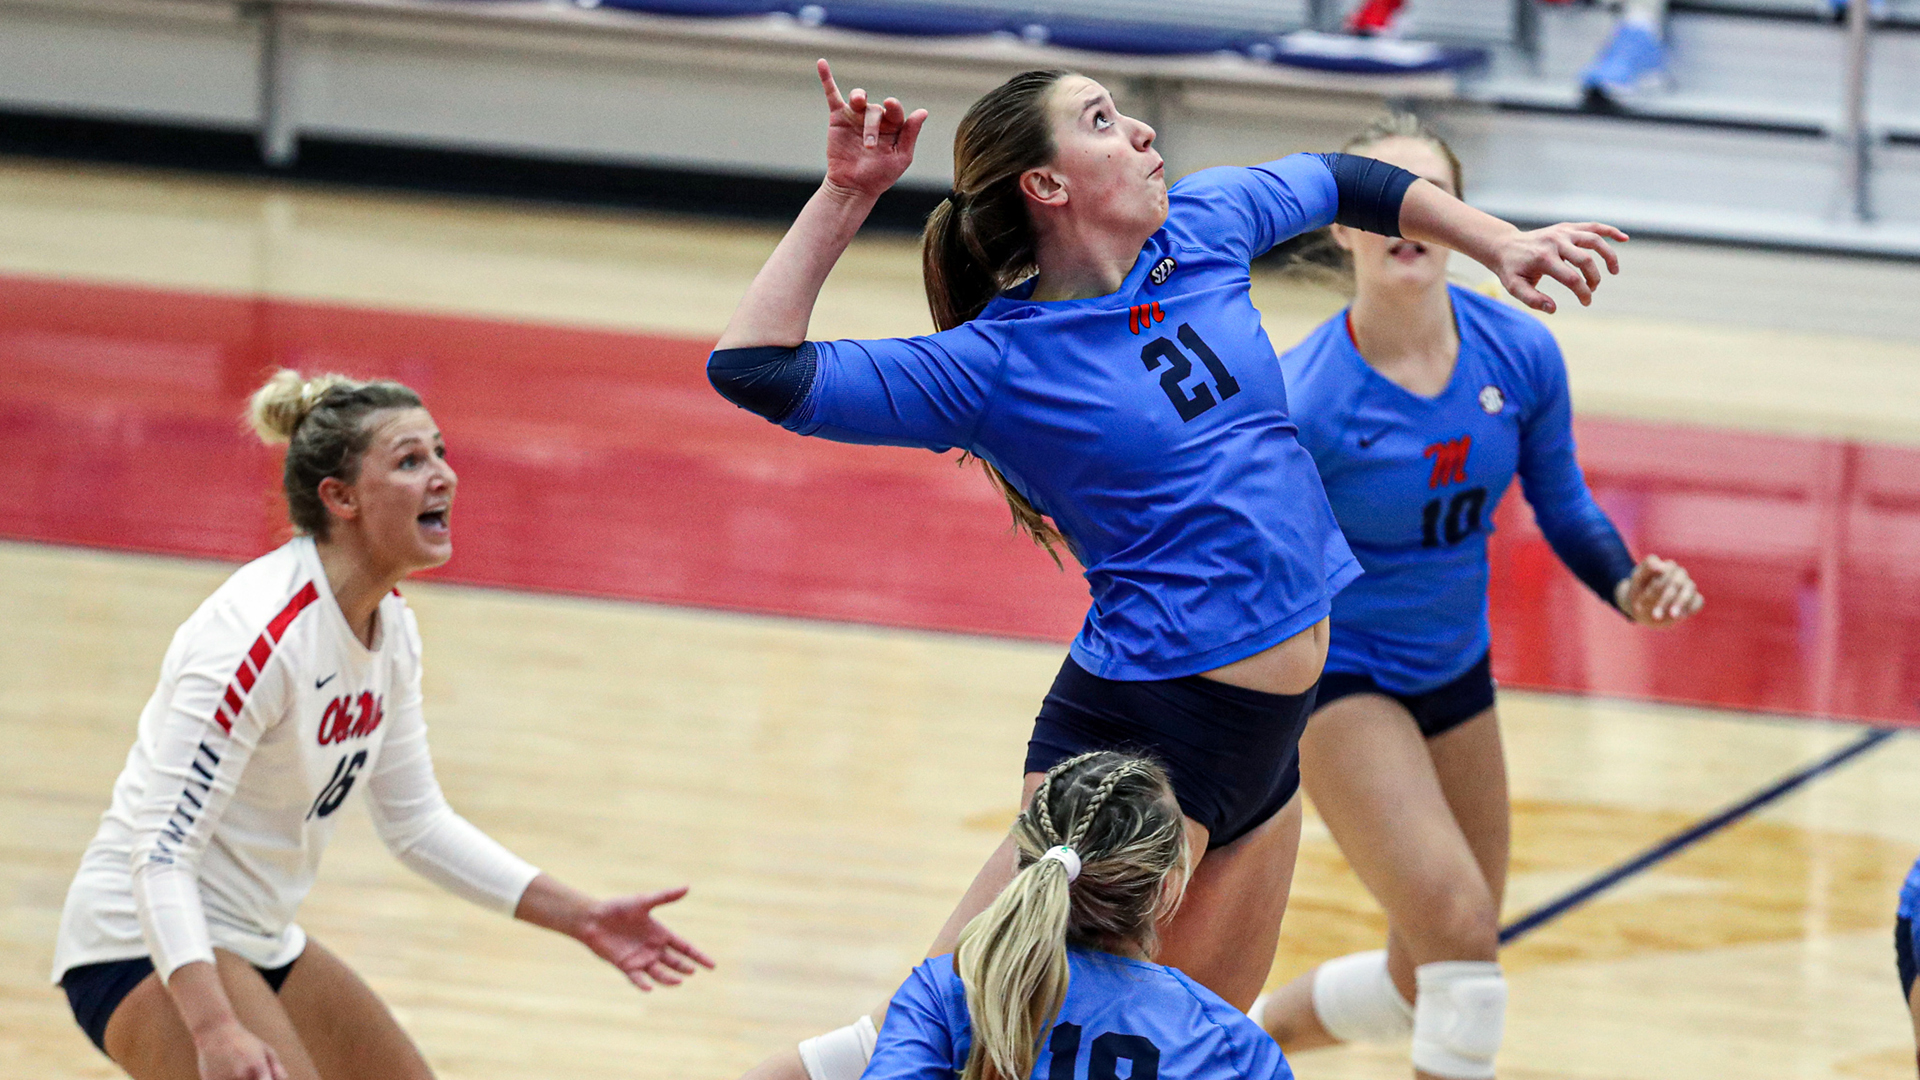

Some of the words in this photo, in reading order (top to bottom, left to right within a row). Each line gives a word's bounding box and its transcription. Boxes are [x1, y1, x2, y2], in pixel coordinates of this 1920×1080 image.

[1151, 258, 1175, 285] SEC
[1140, 322, 1241, 423] 21
[1421, 486, 1487, 547] 10
[305, 749, 368, 820] 16
